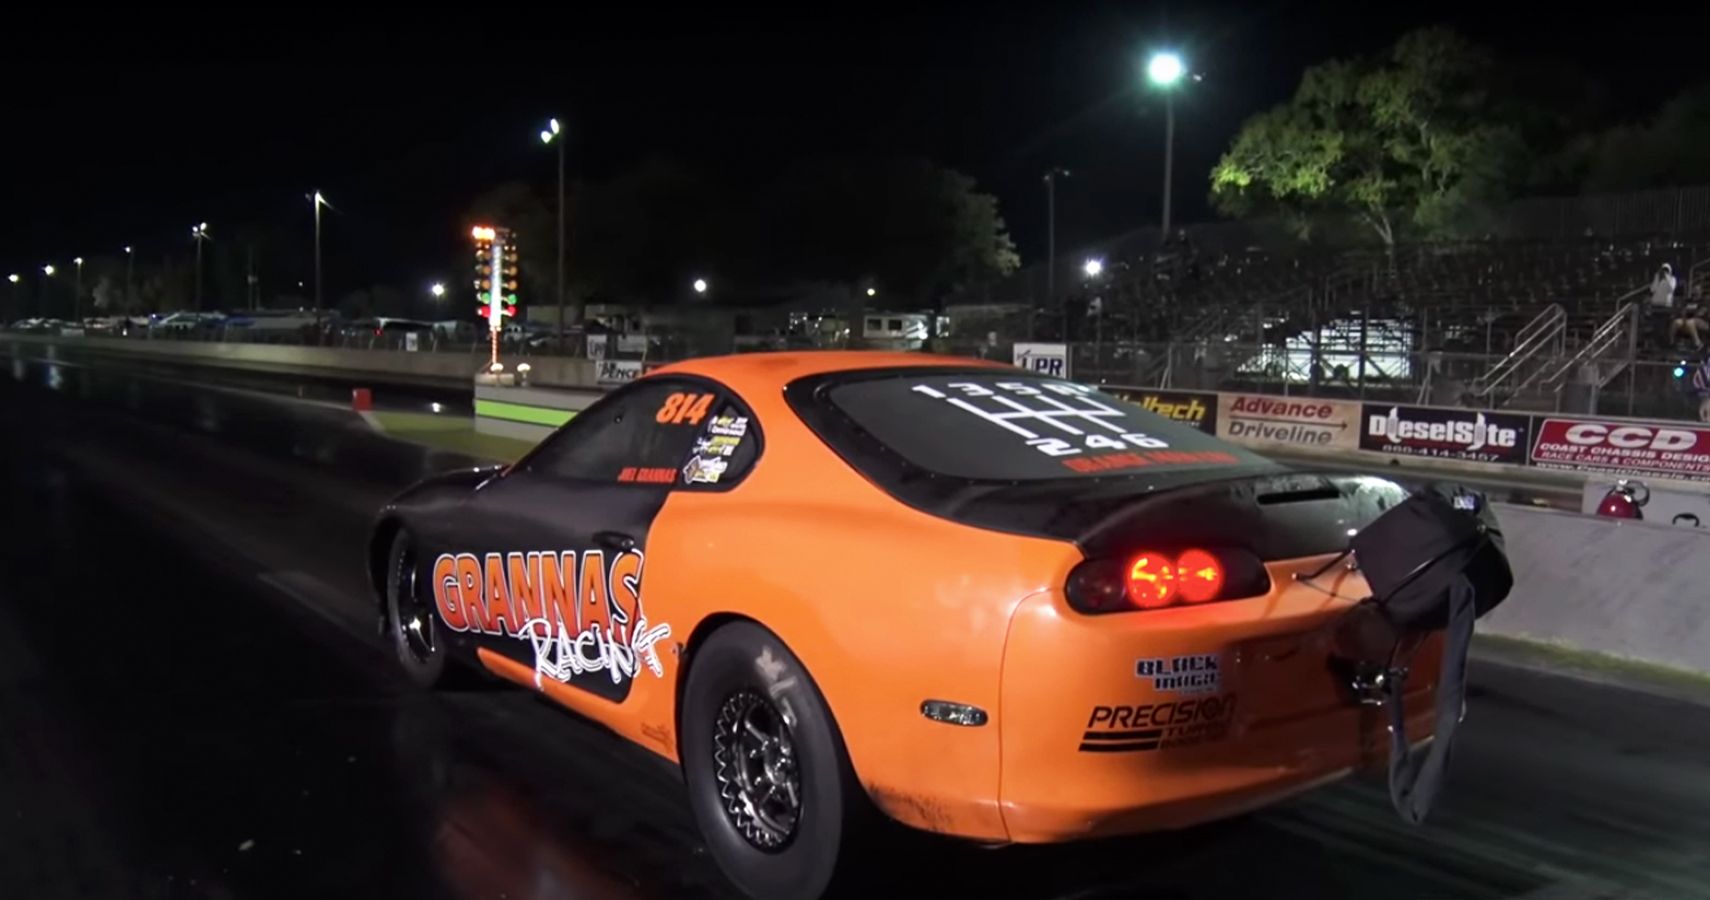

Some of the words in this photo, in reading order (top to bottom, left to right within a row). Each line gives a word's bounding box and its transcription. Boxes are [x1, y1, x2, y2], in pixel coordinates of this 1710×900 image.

[656, 392, 715, 424] 814
[1230, 397, 1333, 419] Advance
[1025, 438, 1082, 456] 2
[1085, 434, 1129, 450] 4
[1120, 433, 1169, 448] 6
[1228, 421, 1333, 445] Driveline
[1565, 424, 1697, 450] CCD
[1540, 443, 1587, 453] COAST
[1591, 446, 1656, 460] CHASSIS
[1541, 451, 1571, 460] RACE
[1576, 454, 1607, 464] CARS
[432, 549, 648, 648] GRANNAS
[519, 616, 671, 691] RACING
[1087, 692, 1237, 728] PRECISION
